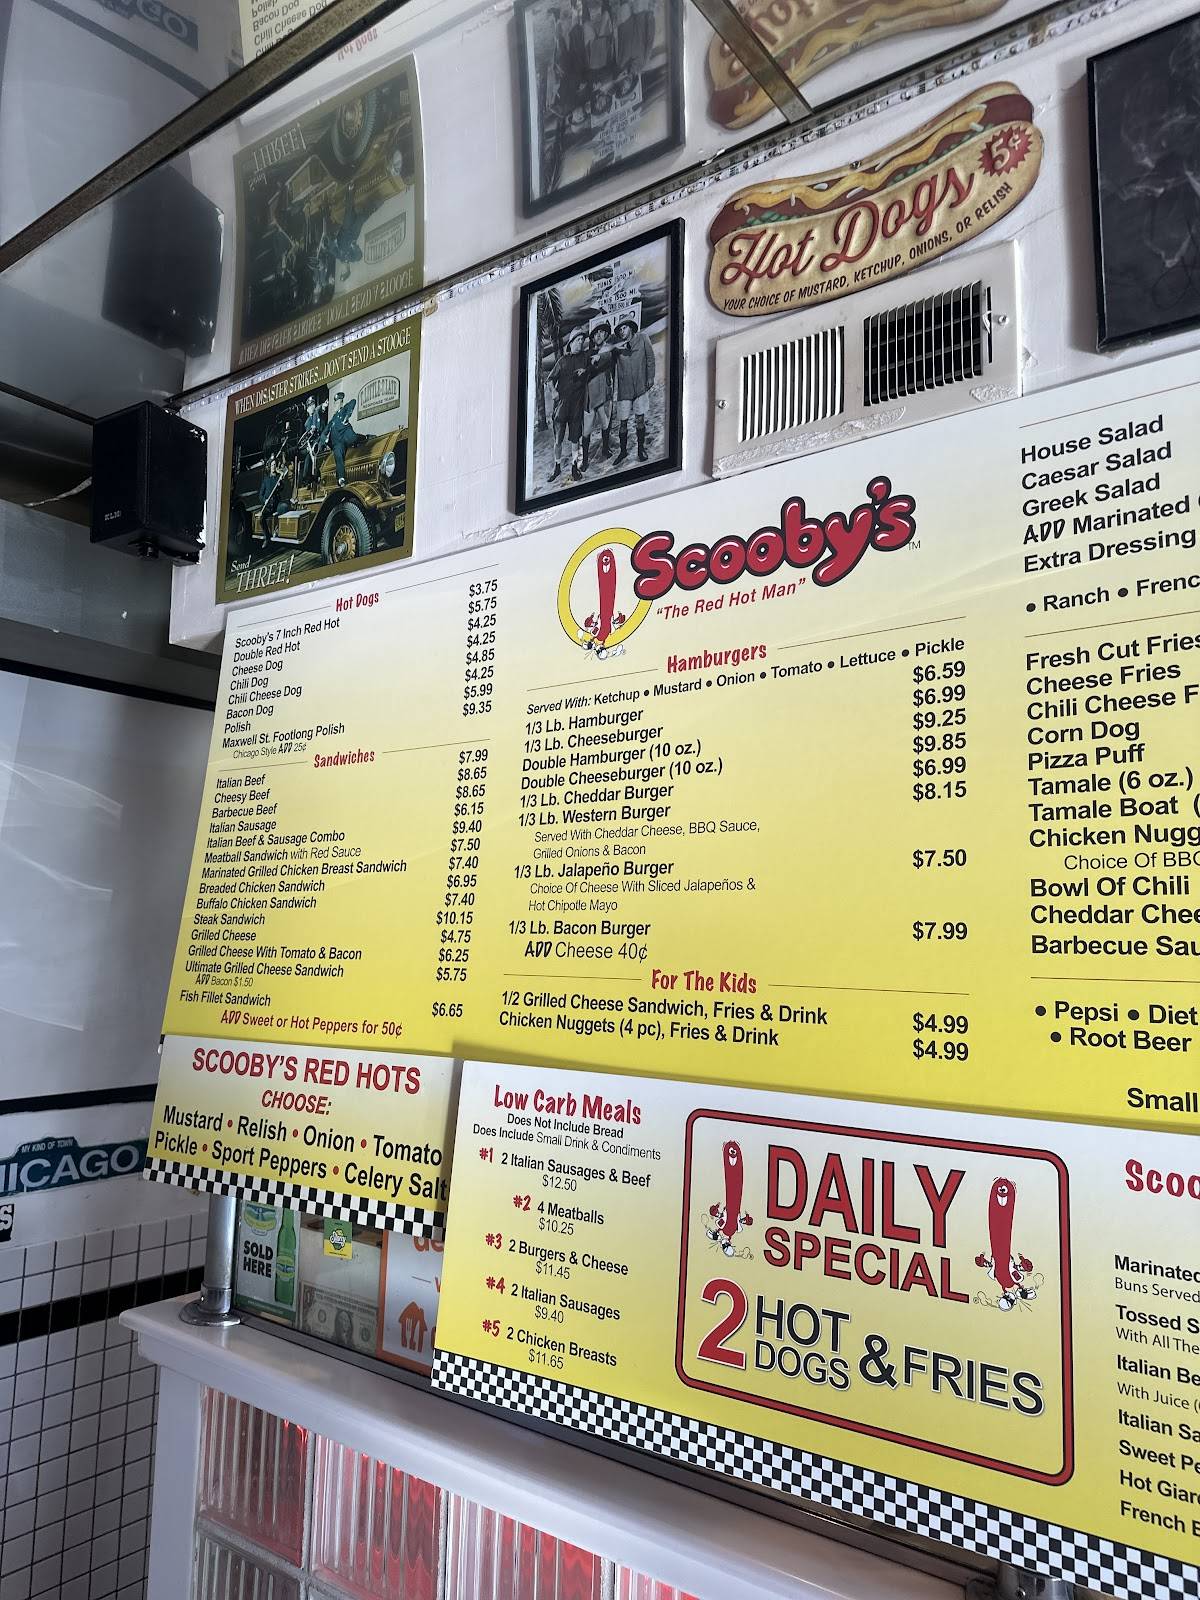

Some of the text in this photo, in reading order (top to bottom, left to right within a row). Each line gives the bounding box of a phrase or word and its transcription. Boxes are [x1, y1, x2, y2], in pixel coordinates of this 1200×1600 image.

[991, 126, 1021, 168] 5¢
[721, 168, 974, 294] Hot Dogs
[724, 182, 1013, 310] YOUR CHOICE OF MUSTARD, KETCHUP, ONIONS, OR RELISH
[235, 394, 255, 416] WHEN
[256, 380, 288, 406] DISASTER
[348, 347, 370, 369] SEND
[370, 345, 376, 360] A
[378, 326, 412, 356] STOOGE
[1021, 414, 1163, 464] House Salad
[1022, 441, 1172, 490] Caesar Salad
[630, 476, 916, 600] Scooby's
[908, 540, 921, 550] TM
[1024, 529, 1196, 573] Extra Dressing
[231, 554, 252, 572] Send
[236, 554, 294, 593] THREE!
[469, 578, 498, 598] $3.75
[695, 594, 724, 612] Red
[729, 590, 756, 606] Hot
[336, 592, 379, 612] Hot Dogs
[235, 617, 340, 648] Scooby's 7 Inch Red Hot
[667, 644, 767, 674] Hamburgers
[526, 637, 965, 715] Served With: Ketchup Mustard Onion Tomato Lettuce Pickle
[912, 660, 966, 685] $6.59
[228, 685, 302, 705] Chili Cheese Dog
[462, 700, 492, 717] $9.35
[222, 722, 345, 748] Maxwell St. Footlong Polish
[233, 741, 307, 760] Chicago Style ADD 25¢
[314, 748, 375, 768] Sandwiches
[458, 748, 488, 765] $7.99
[1028, 743, 1146, 771] Pizza Puff
[216, 773, 266, 789] Italian Beef
[204, 846, 362, 864] Meatball Sandwich with Red Sauce
[530, 877, 756, 894] Choice Of Cheese With Sliced Jalapeños &
[436, 910, 474, 926] $10.15
[912, 920, 968, 942] $7.99
[194, 973, 254, 987] ADD Bacon $1.50
[652, 969, 756, 994] For The Kids
[1055, 1000, 1199, 1026] Pepsi Diet
[1070, 1026, 1192, 1052] Root Beer
[192, 1048, 421, 1094] SCOOBY'S RED HOTS
[261, 1090, 332, 1116] CHOOSE:
[494, 1084, 641, 1125] Low Carb Meals
[163, 1105, 443, 1166] Mustard Relish Onion Tomato
[507, 1113, 624, 1139] Does Not Include Bread
[32, 1143, 46, 1152] KIND
[58, 1139, 74, 1148] TOWN
[473, 1123, 661, 1160] Does Include Small Drink & Condiments
[0, 1145, 139, 1194] ICAGO
[154, 1130, 448, 1201] Pickle Sport Peppers Celery Salt
[766, 1144, 966, 1248] DAILY
[513, 1194, 604, 1225] #2 4 Meatballs
[538, 1216, 574, 1236] $10.25
[243, 1240, 274, 1260] SOLD
[243, 1256, 272, 1278] HERE
[764, 1226, 970, 1303] SPECIAL
[1115, 1276, 1148, 1294] Buns
[697, 1278, 749, 1370] 2
[754, 1295, 850, 1353] HOT
[754, 1340, 850, 1390] DOGS
[858, 1333, 1044, 1416] & FRIES
[1117, 1382, 1190, 1410] With Juice
